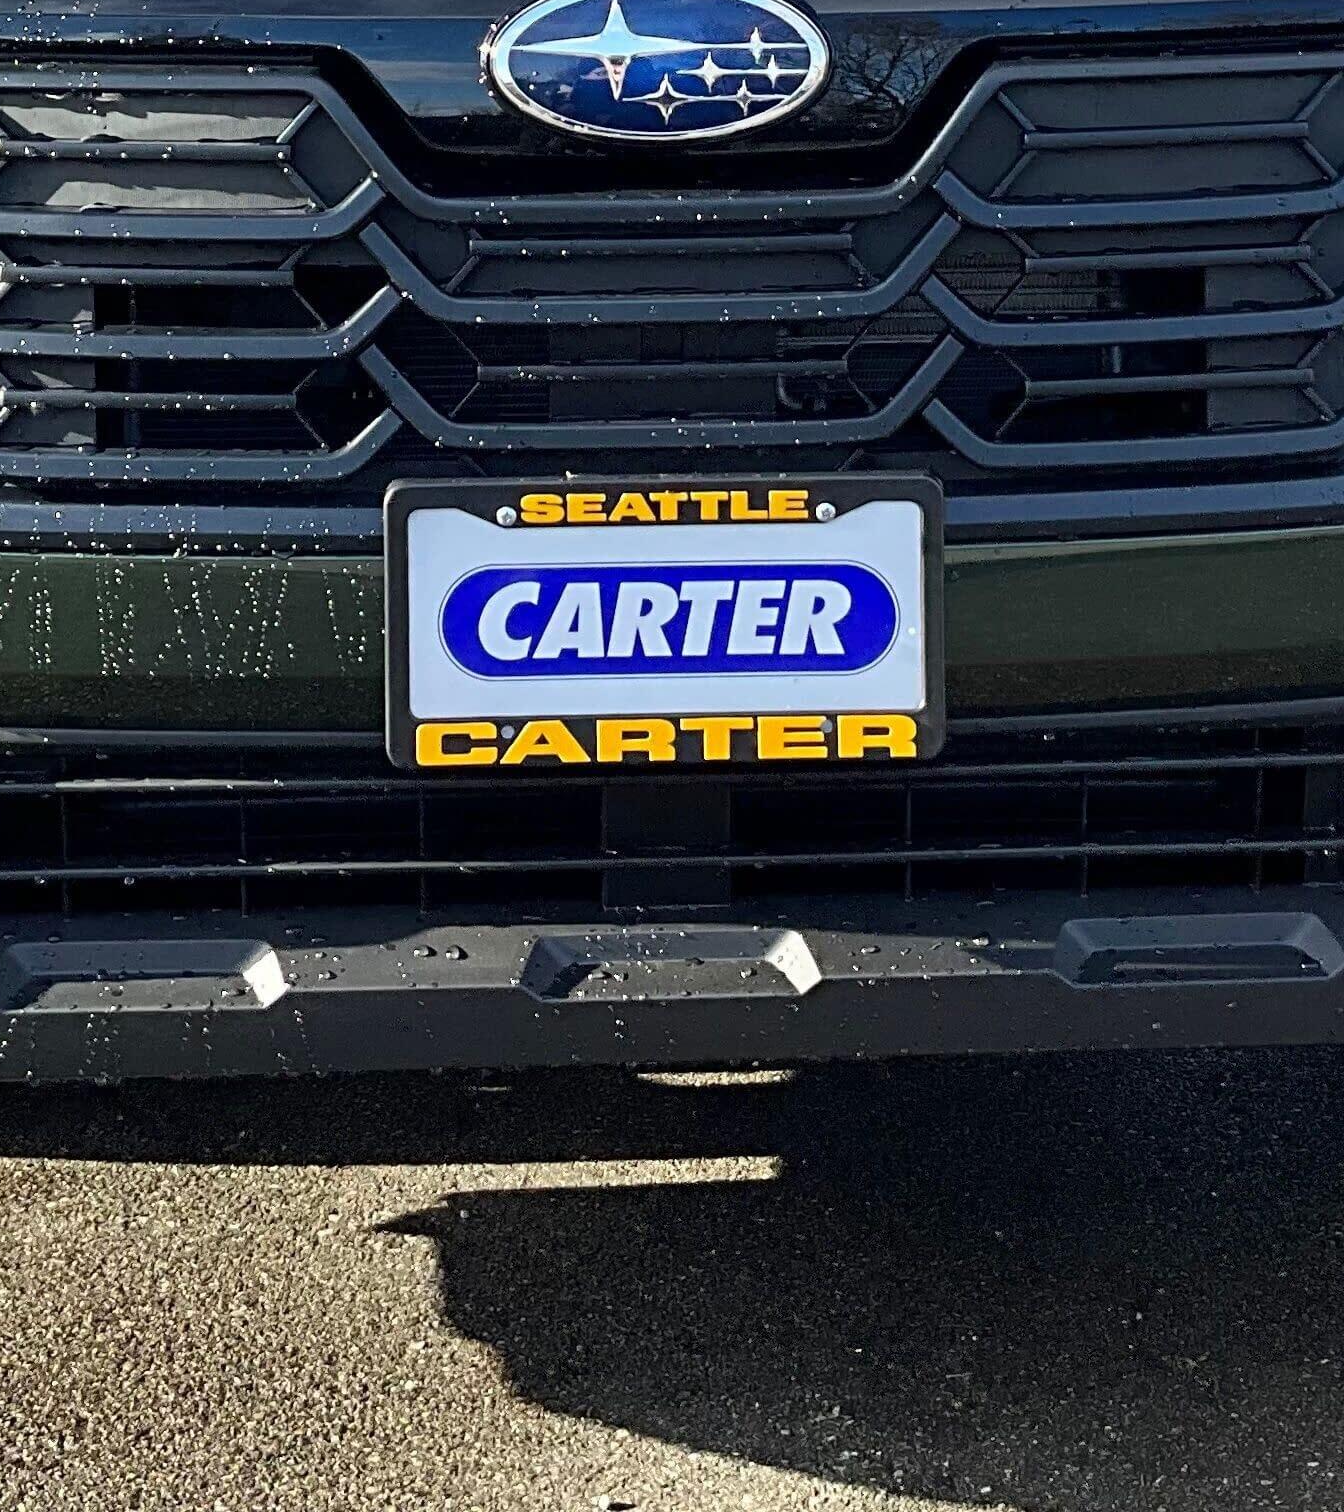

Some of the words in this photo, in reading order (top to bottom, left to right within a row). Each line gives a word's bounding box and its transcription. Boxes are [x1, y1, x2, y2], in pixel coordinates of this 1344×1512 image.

[519, 489, 810, 525] SEATTLE
[477, 579, 852, 661] CARTER
[415, 714, 918, 767] CARTER
